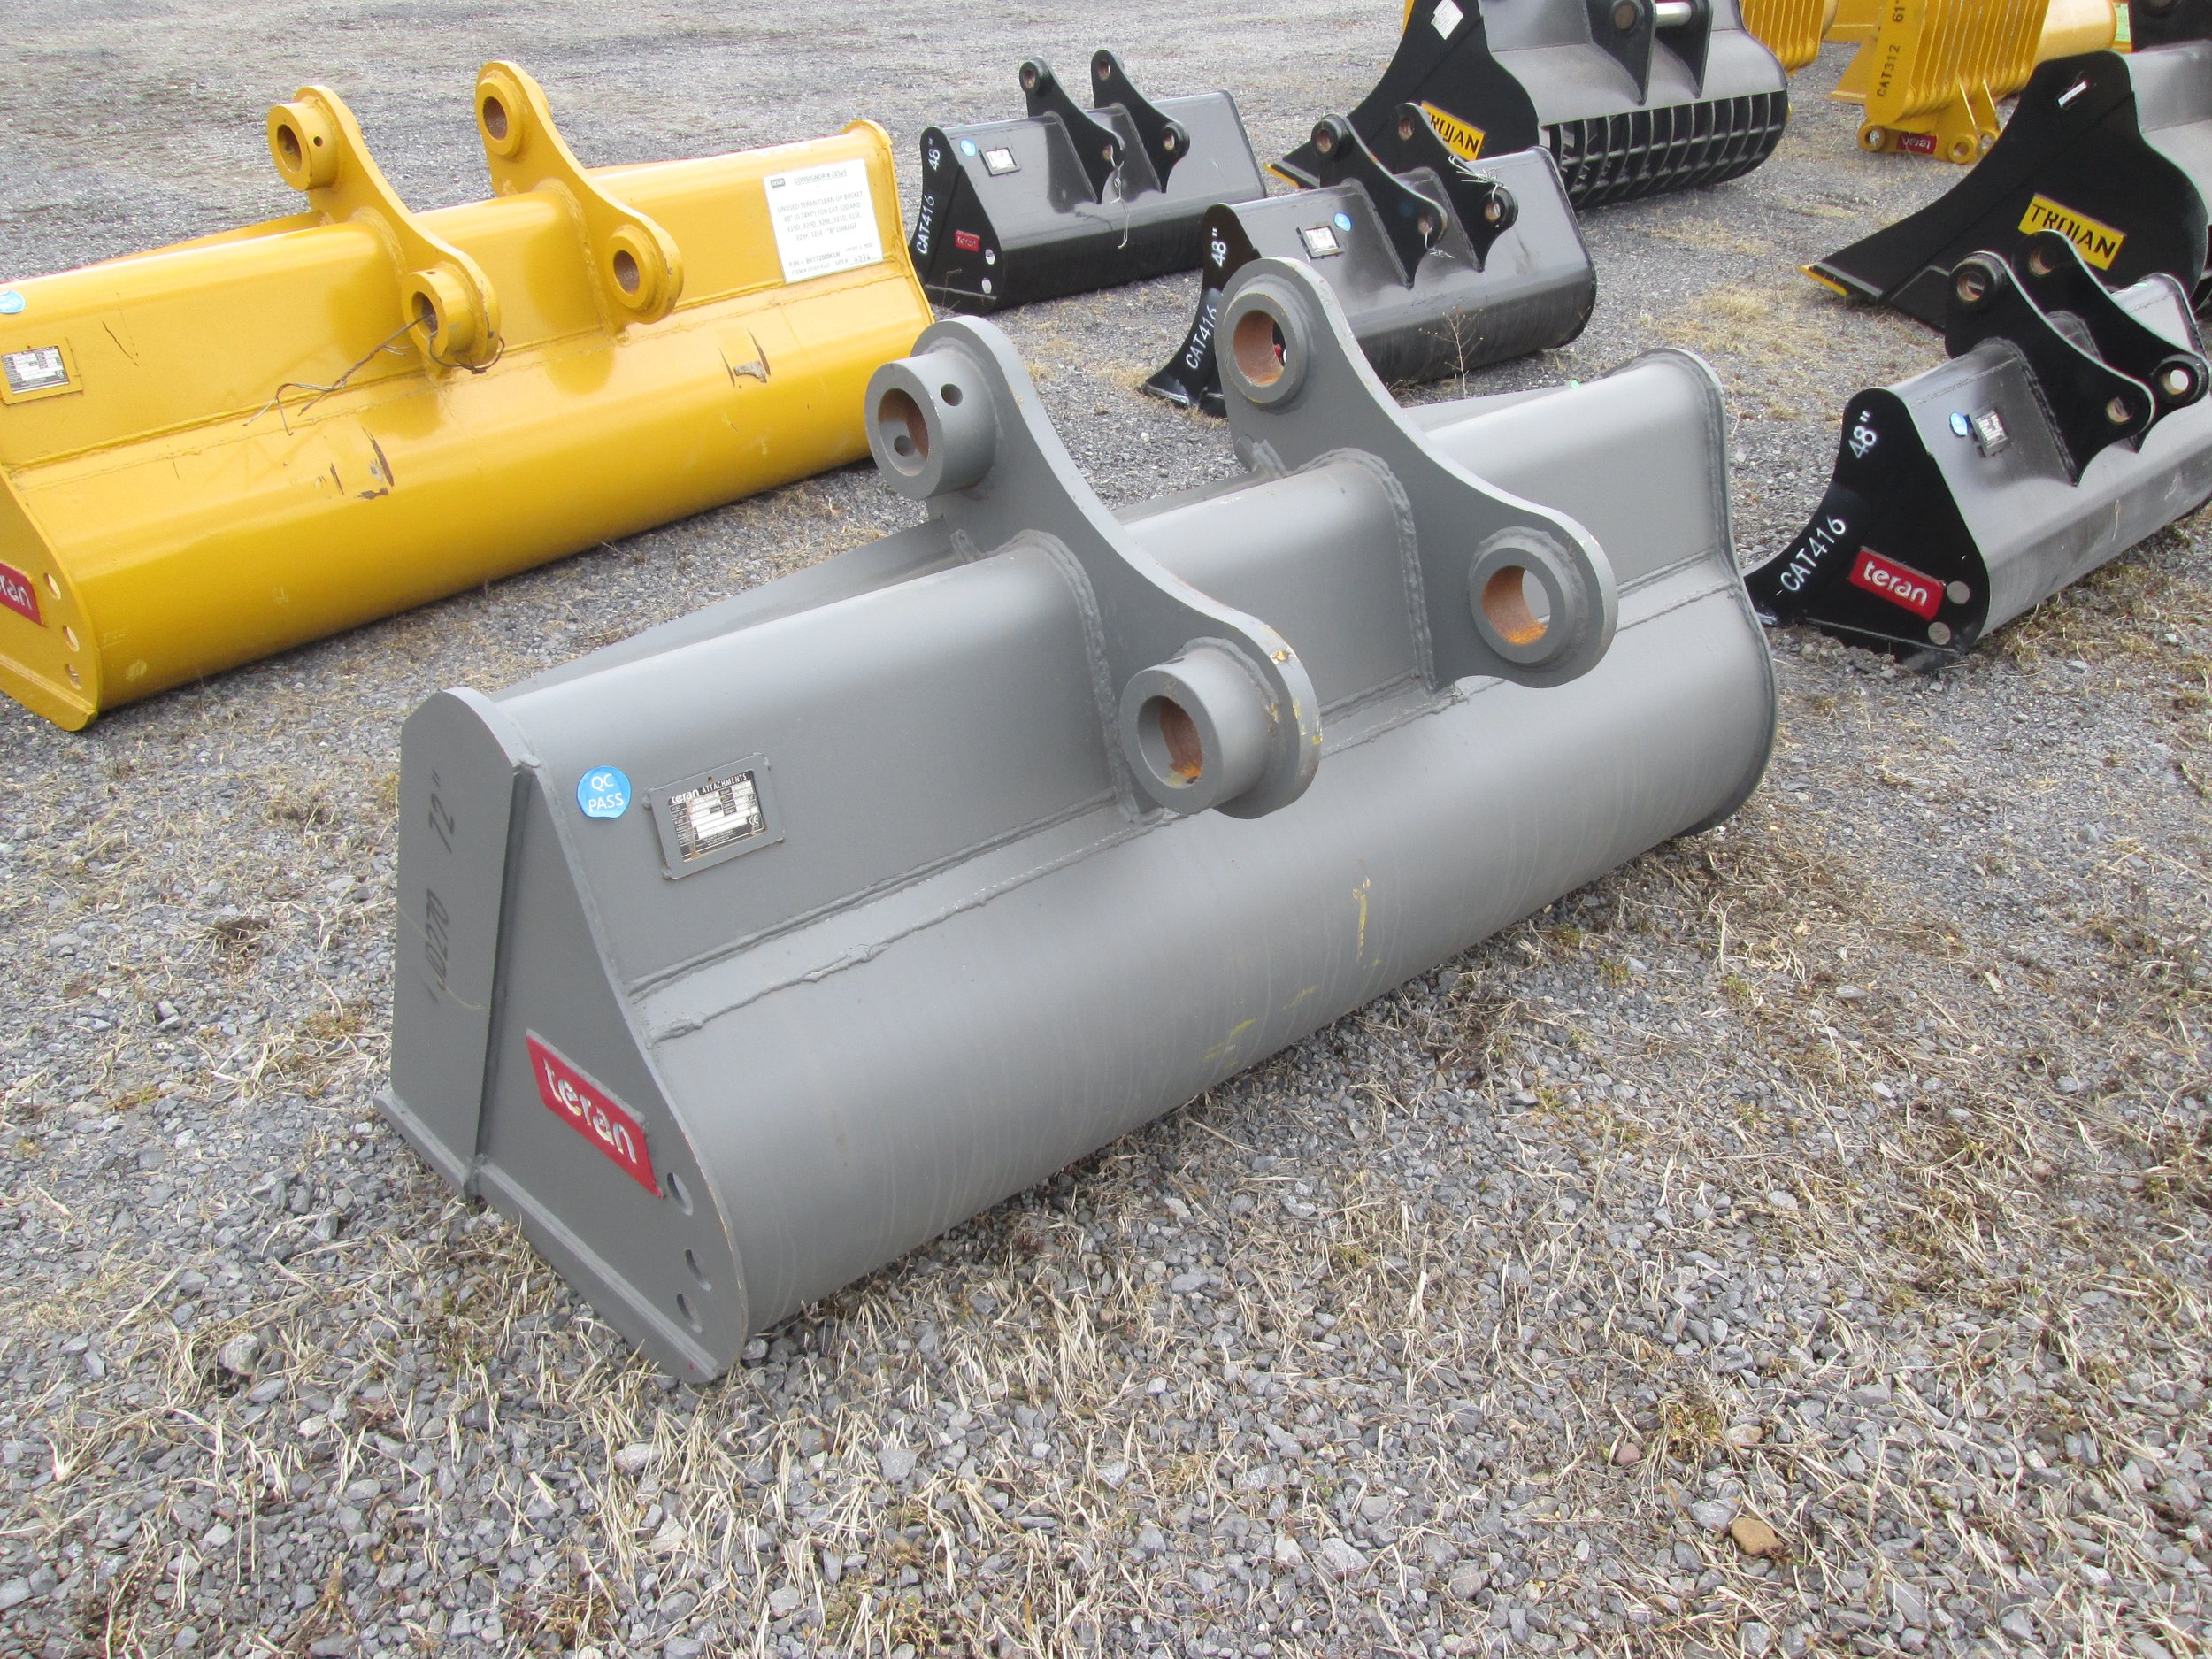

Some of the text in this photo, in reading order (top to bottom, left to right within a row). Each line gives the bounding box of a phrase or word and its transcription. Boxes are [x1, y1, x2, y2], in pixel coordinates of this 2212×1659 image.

[1877, 44, 1900, 97] CAT312
[928, 138, 941, 171] 48"
[1426, 111, 1479, 154] ROJAN
[843, 190, 863, 200] BUCKET
[916, 194, 936, 255] CAT416
[2033, 203, 2116, 258] TROJAN
[1210, 227, 1227, 268] 48"
[1849, 411, 1877, 459] 48"
[1780, 515, 1846, 591] CAT416
[1863, 560, 1928, 606] teran
[588, 793, 624, 812] PASS
[591, 773, 614, 792] QC
[671, 788, 700, 804] teran
[702, 773, 748, 795] ATTACHMENTS
[542, 1056, 637, 1164] teran
